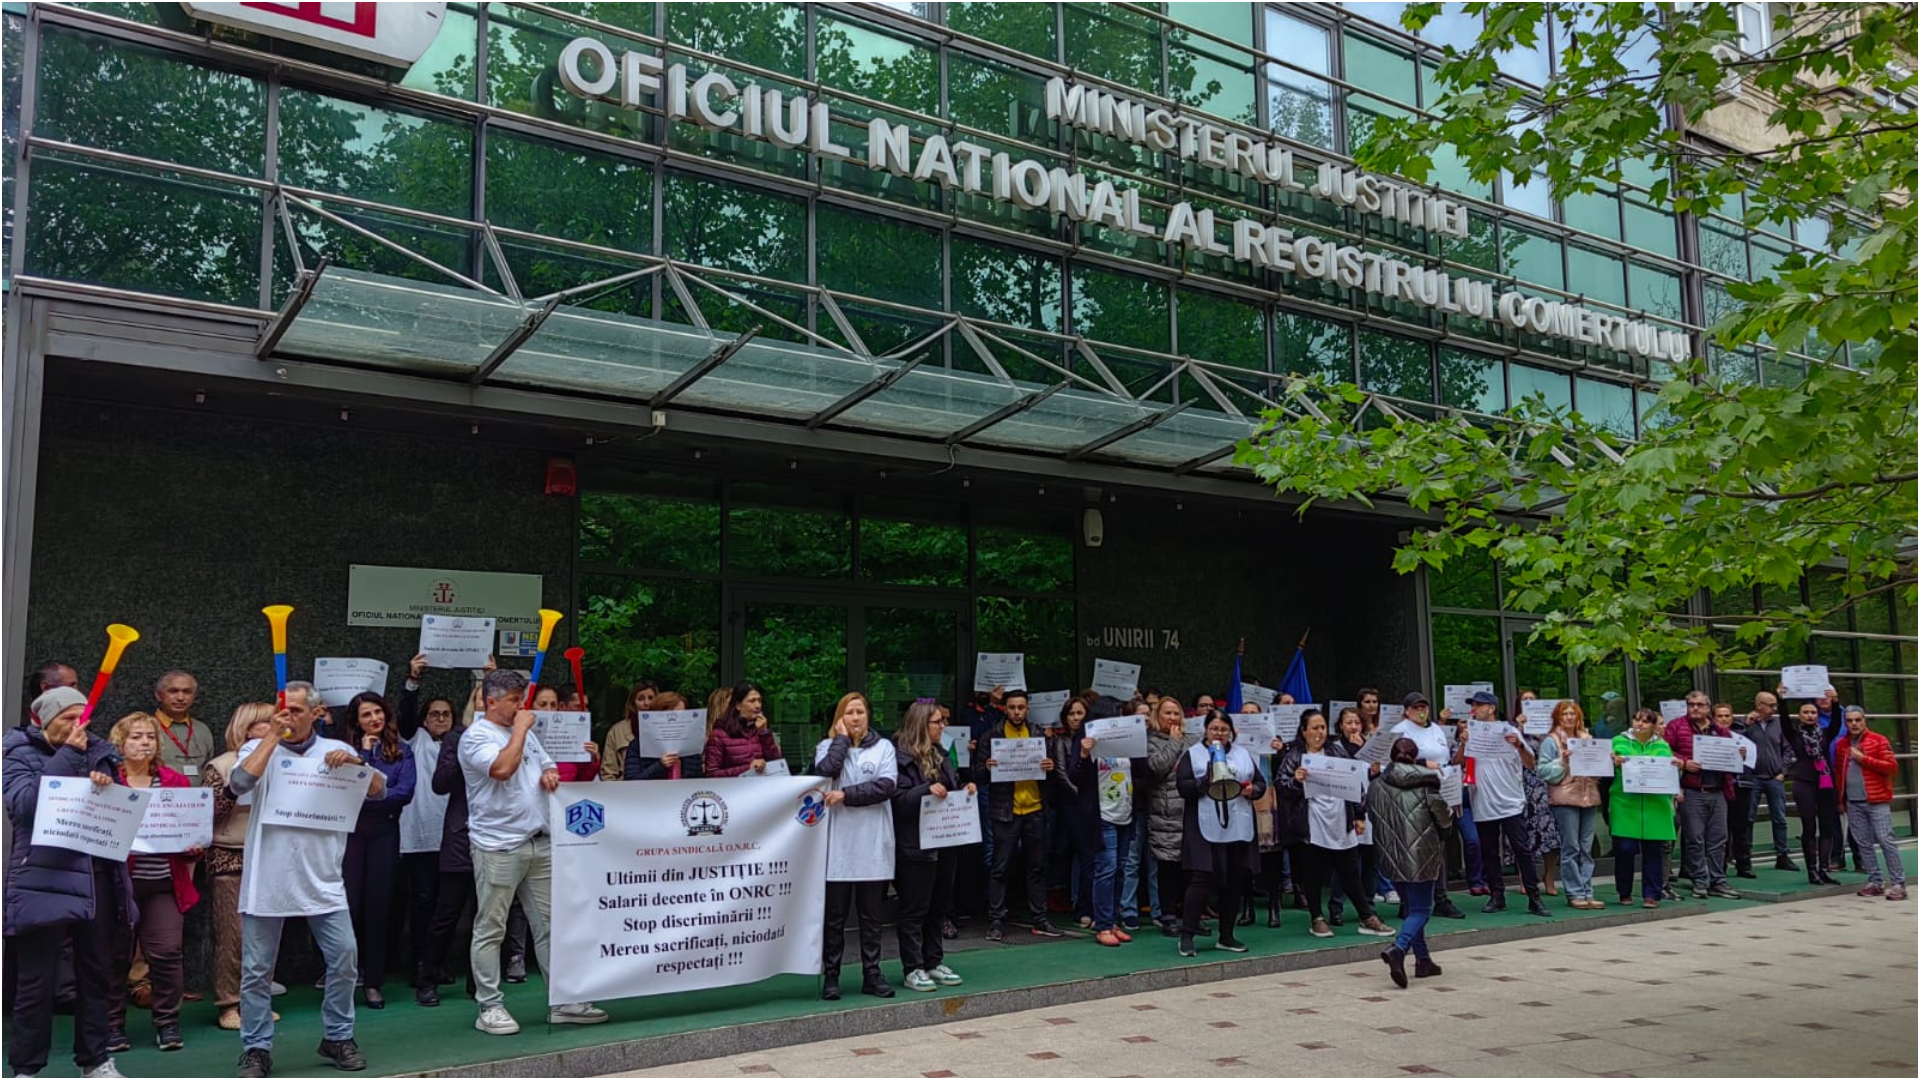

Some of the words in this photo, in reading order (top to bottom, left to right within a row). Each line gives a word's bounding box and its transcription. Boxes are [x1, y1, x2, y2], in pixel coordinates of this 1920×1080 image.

[1046, 76, 1305, 192] MINISTERUL
[1310, 162, 1468, 239] JUSTITIEI
[558, 37, 851, 160] OFICIUL
[868, 117, 1156, 236] NATIONAL
[1164, 202, 1232, 257] AL
[1233, 217, 1493, 320] REGISTRULUI
[1500, 291, 1691, 363] COMERTULUI
[352, 611, 384, 619] OFICIUL
[386, 612, 421, 620] NATIONA
[1087, 636, 1100, 646] bd
[1104, 627, 1154, 648] UNIRII
[1162, 630, 1180, 649] 74
[636, 847, 670, 857] GRUPA
[672, 843, 724, 856] SINDICALĂ
[726, 841, 761, 852] O.N.R.C.
[606, 870, 657, 886] Ultimii
[661, 868, 685, 882] din
[688, 862, 765, 881] JUSTIȚIE
[769, 861, 788, 875] !!!!
[598, 894, 647, 910] Salarii
[652, 892, 707, 906] decente
[710, 889, 725, 901] în
[729, 884, 775, 900] ONRC
[779, 882, 792, 895] !!!
[623, 917, 657, 933] Stop
[662, 909, 753, 929] discriminării
[757, 906, 772, 920] !!!
[600, 943, 650, 958] Mereu
[654, 933, 728, 953] sacrificați,
[732, 924, 786, 945] niciodată
[656, 954, 724, 974] respectați
[728, 951, 743, 966] !!!
